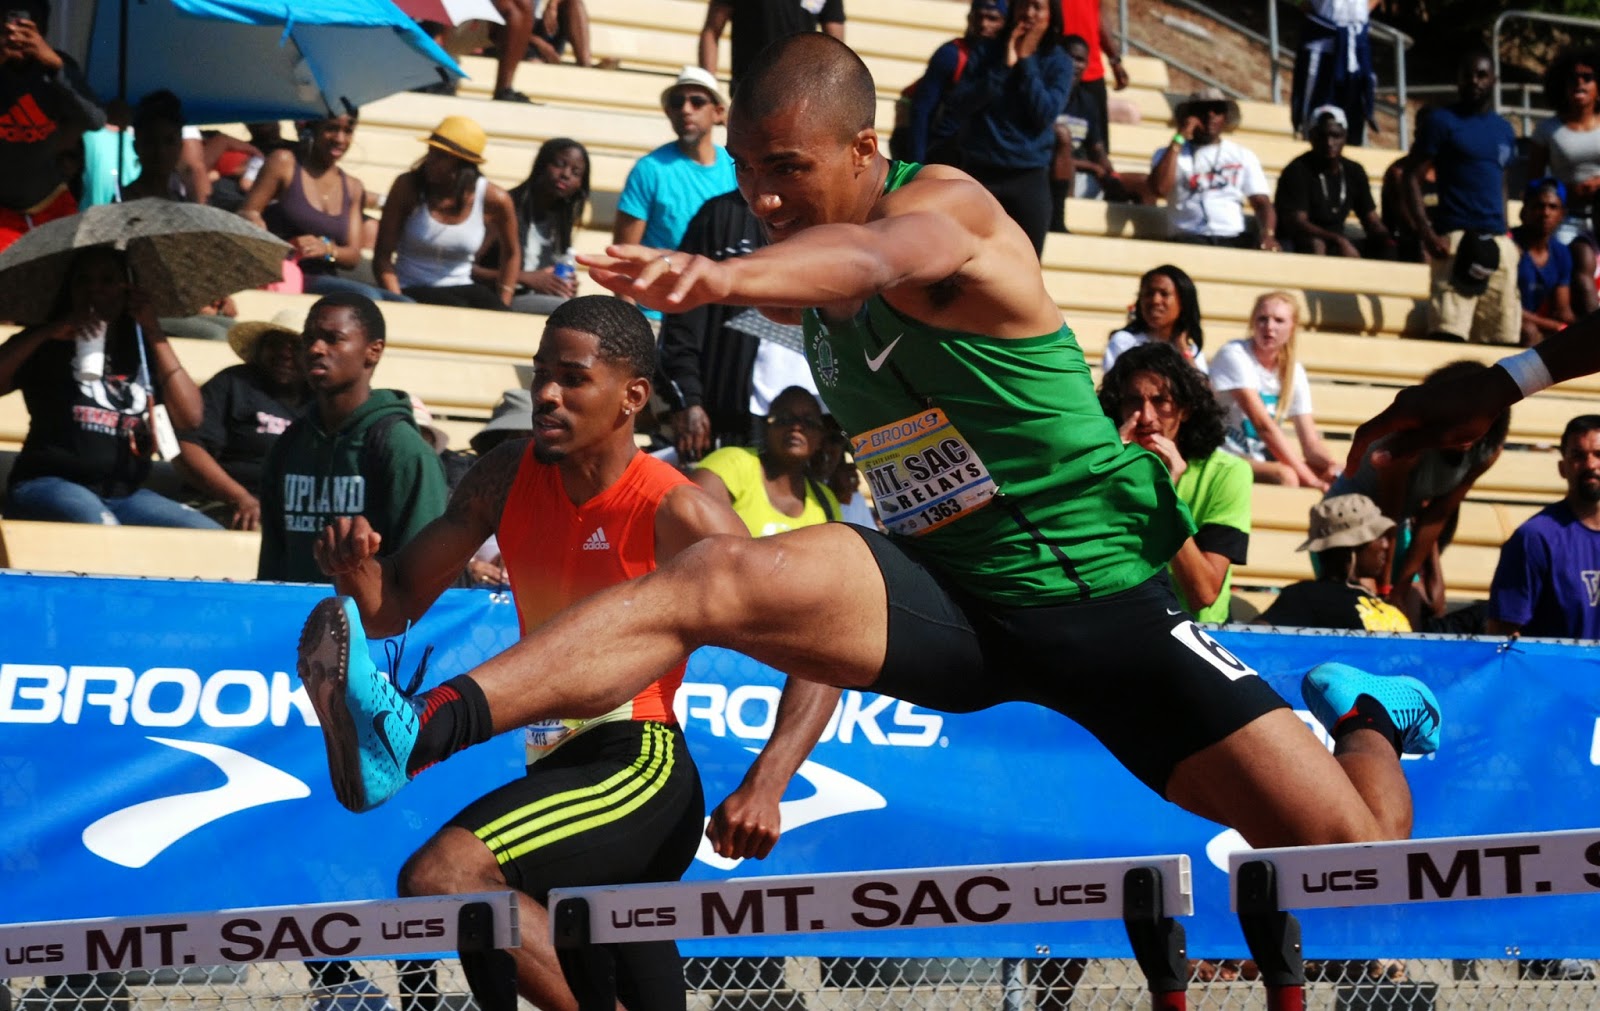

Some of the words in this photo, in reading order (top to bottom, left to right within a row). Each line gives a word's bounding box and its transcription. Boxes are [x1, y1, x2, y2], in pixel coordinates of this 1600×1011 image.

[870, 412, 938, 448] BROOKS
[866, 463, 913, 498] MT.
[903, 437, 970, 483] SAC
[896, 462, 981, 510] RELAYS
[284, 474, 365, 513] UPLAND
[920, 498, 962, 526] 1363
[284, 514, 316, 532] RACK
[583, 541, 610, 550] adidas
[1190, 623, 1246, 671] 6
[0, 663, 321, 728] BROOK
[673, 682, 943, 747] ROKS
[1302, 868, 1379, 894] UCS
[1407, 845, 1552, 900] MT.
[612, 906, 676, 929] UCS
[701, 886, 824, 936] MT.
[851, 875, 1011, 928] SAC
[1034, 883, 1107, 906] UCS
[6, 944, 64, 965] UCS
[86, 923, 196, 971] MT.
[219, 912, 361, 962] SAC
[382, 917, 445, 940] UCS
